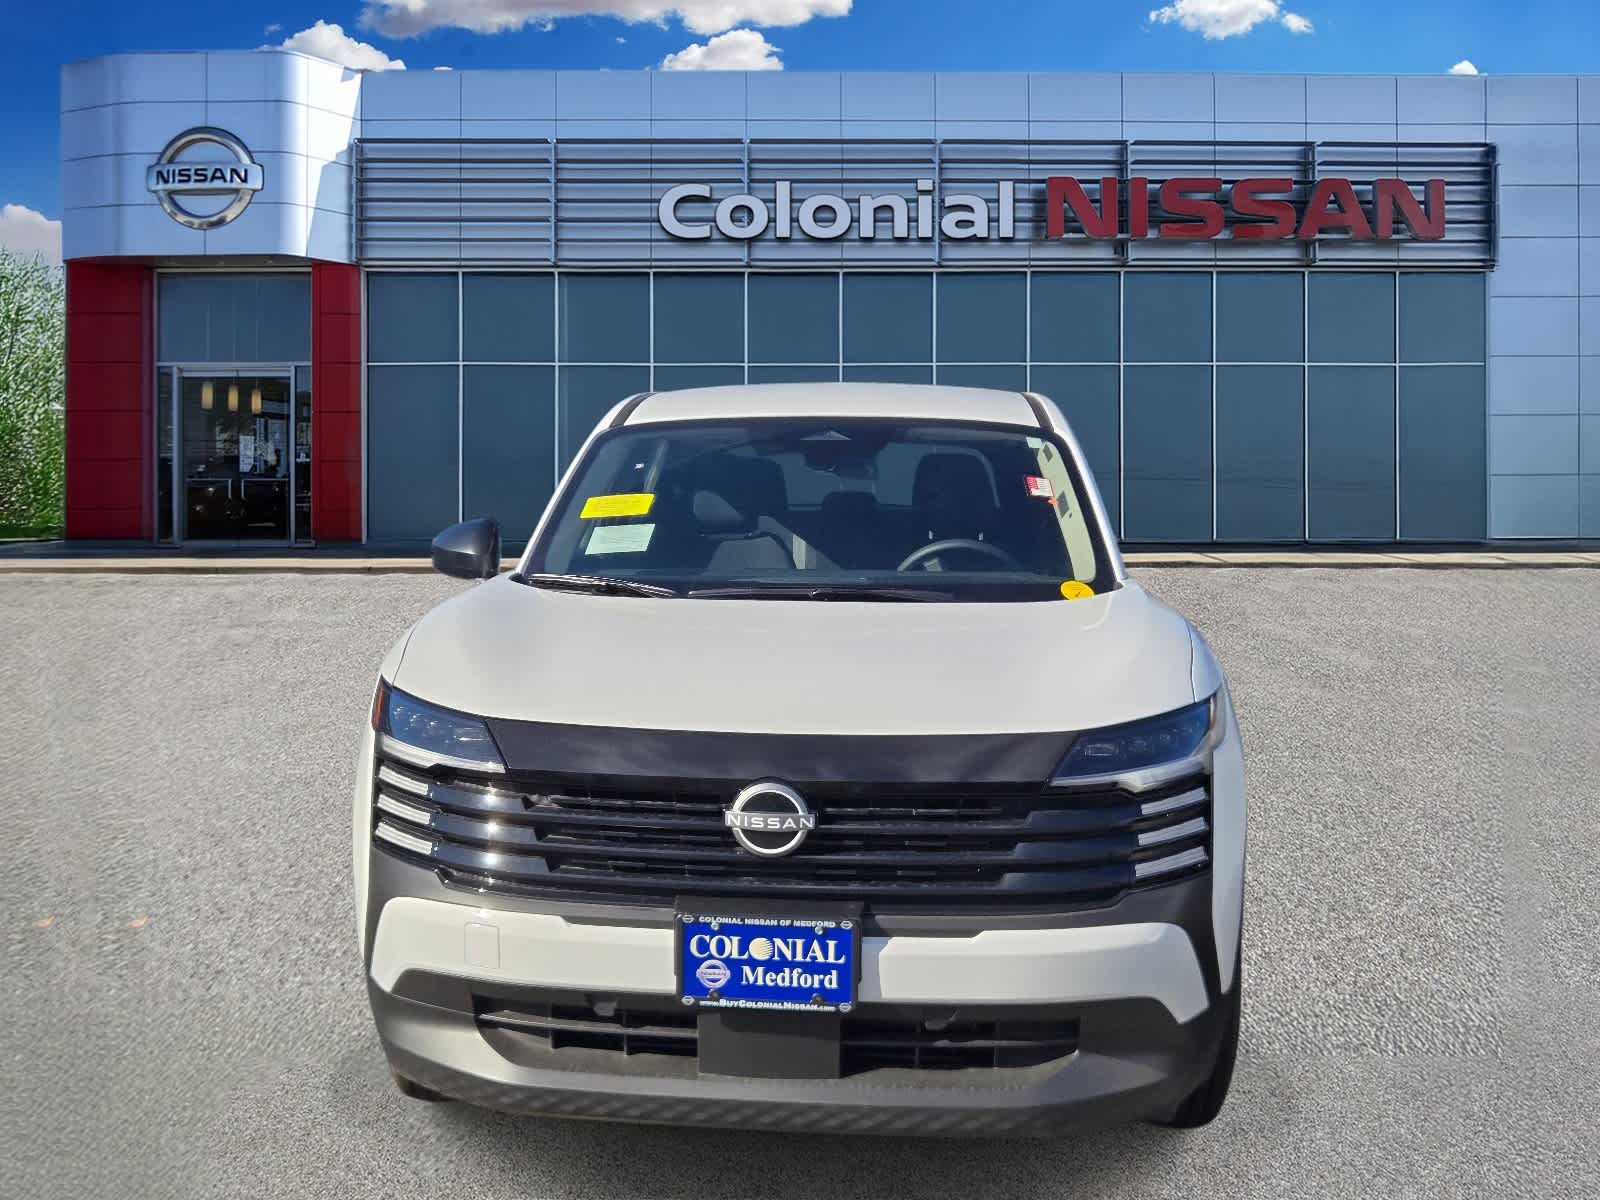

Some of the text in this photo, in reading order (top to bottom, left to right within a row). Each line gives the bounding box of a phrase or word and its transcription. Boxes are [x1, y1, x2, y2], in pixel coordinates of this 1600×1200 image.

[156, 168, 248, 184] NISSAN
[658, 176, 1446, 240] Colonial NISSAN
[727, 812, 814, 829] NISSAN
[699, 916, 743, 925] COLONIAL
[745, 918, 778, 926] NISSAN
[793, 920, 836, 928] MEDFORD
[690, 934, 846, 964] COLONIAL
[741, 966, 838, 989] Medford
